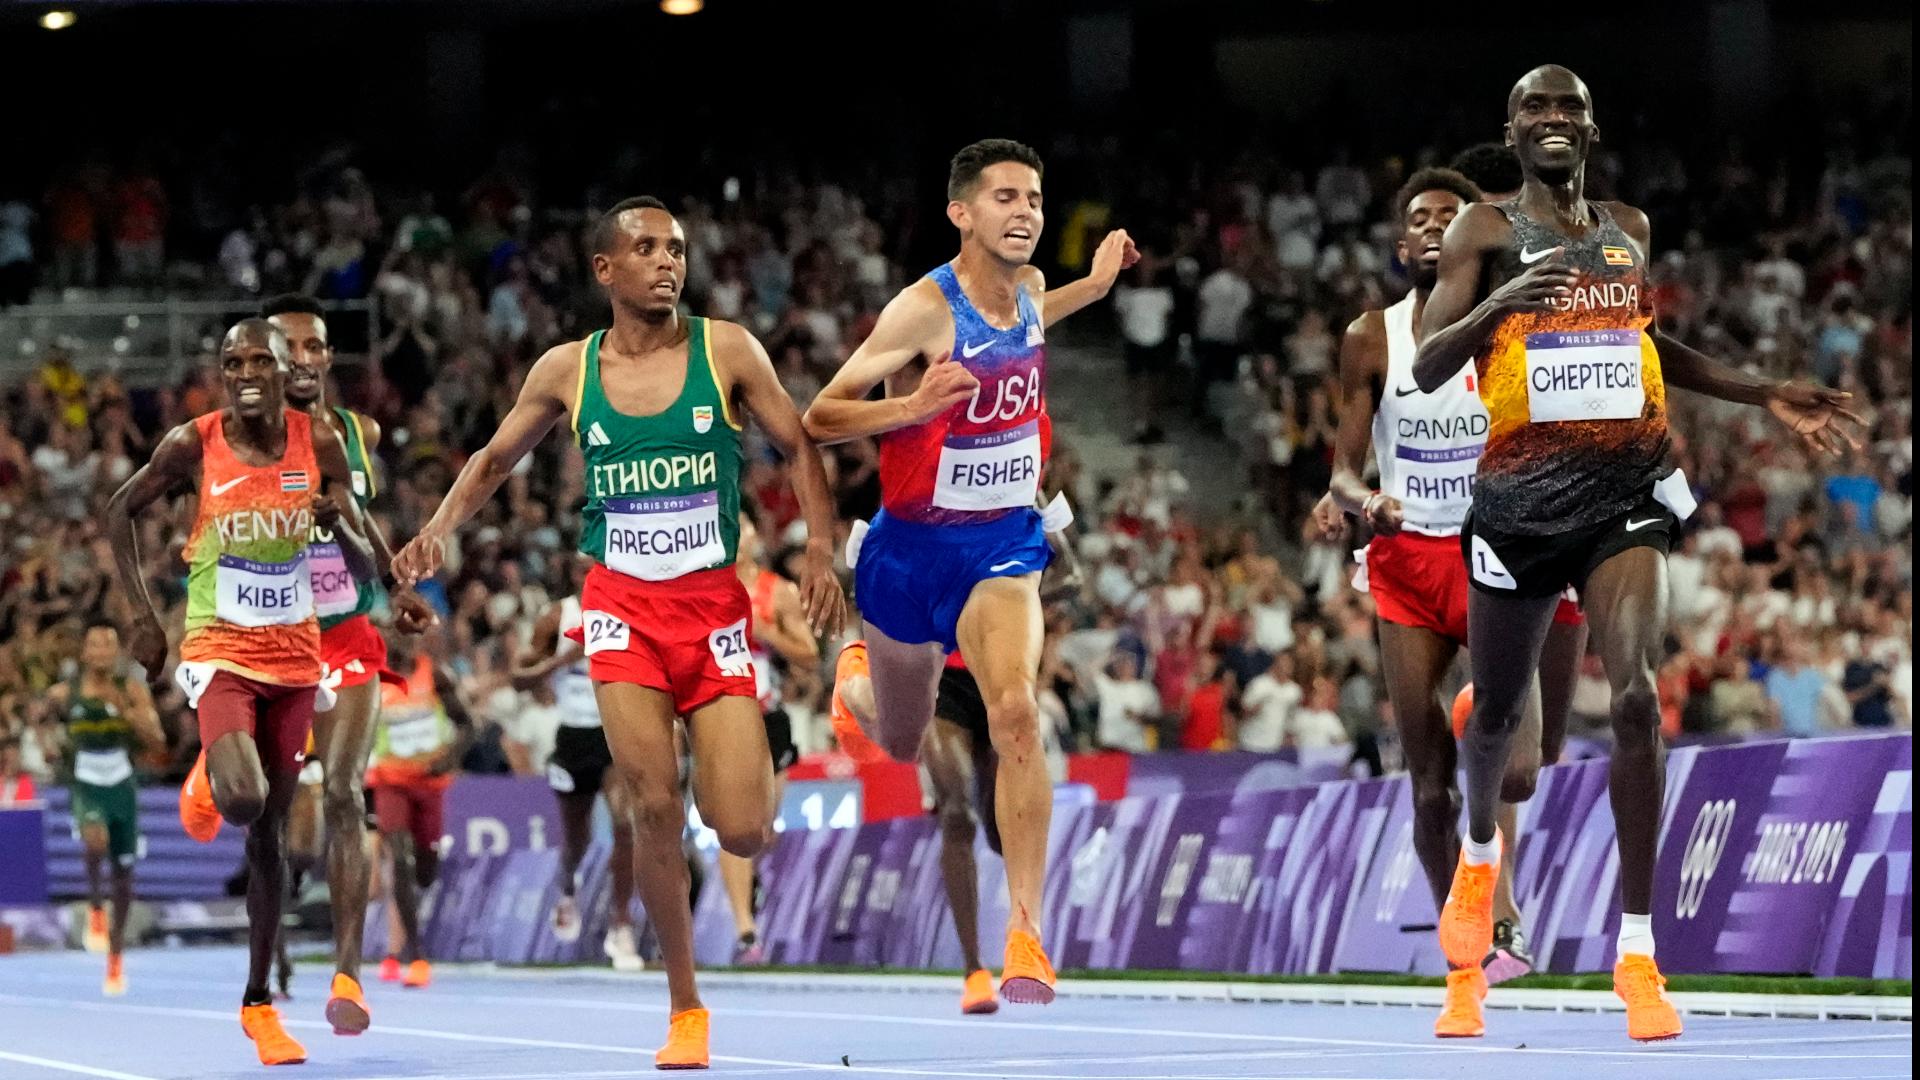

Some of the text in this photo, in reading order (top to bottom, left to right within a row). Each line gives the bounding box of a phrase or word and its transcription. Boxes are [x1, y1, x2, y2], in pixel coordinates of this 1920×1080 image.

[1545, 282, 1639, 312] GANDA
[1559, 333, 1620, 345] PARIS 2024
[966, 366, 1040, 424] USA
[974, 430, 1021, 446] PARIS 2024
[1398, 414, 1488, 440] CANAD
[1420, 451, 1449, 460] PARIS
[593, 451, 717, 497] ETHIOPIA
[951, 455, 1035, 487] FISHER
[1406, 473, 1477, 500] AHM
[629, 500, 691, 511] PARIS 2024
[214, 508, 310, 545] KENYA
[608, 520, 718, 555] AREGAWI
[237, 579, 300, 608] KIBET
[310, 570, 348, 593] EGA
[590, 618, 623, 644] 22
[1746, 820, 1849, 885] PARIS 2024
